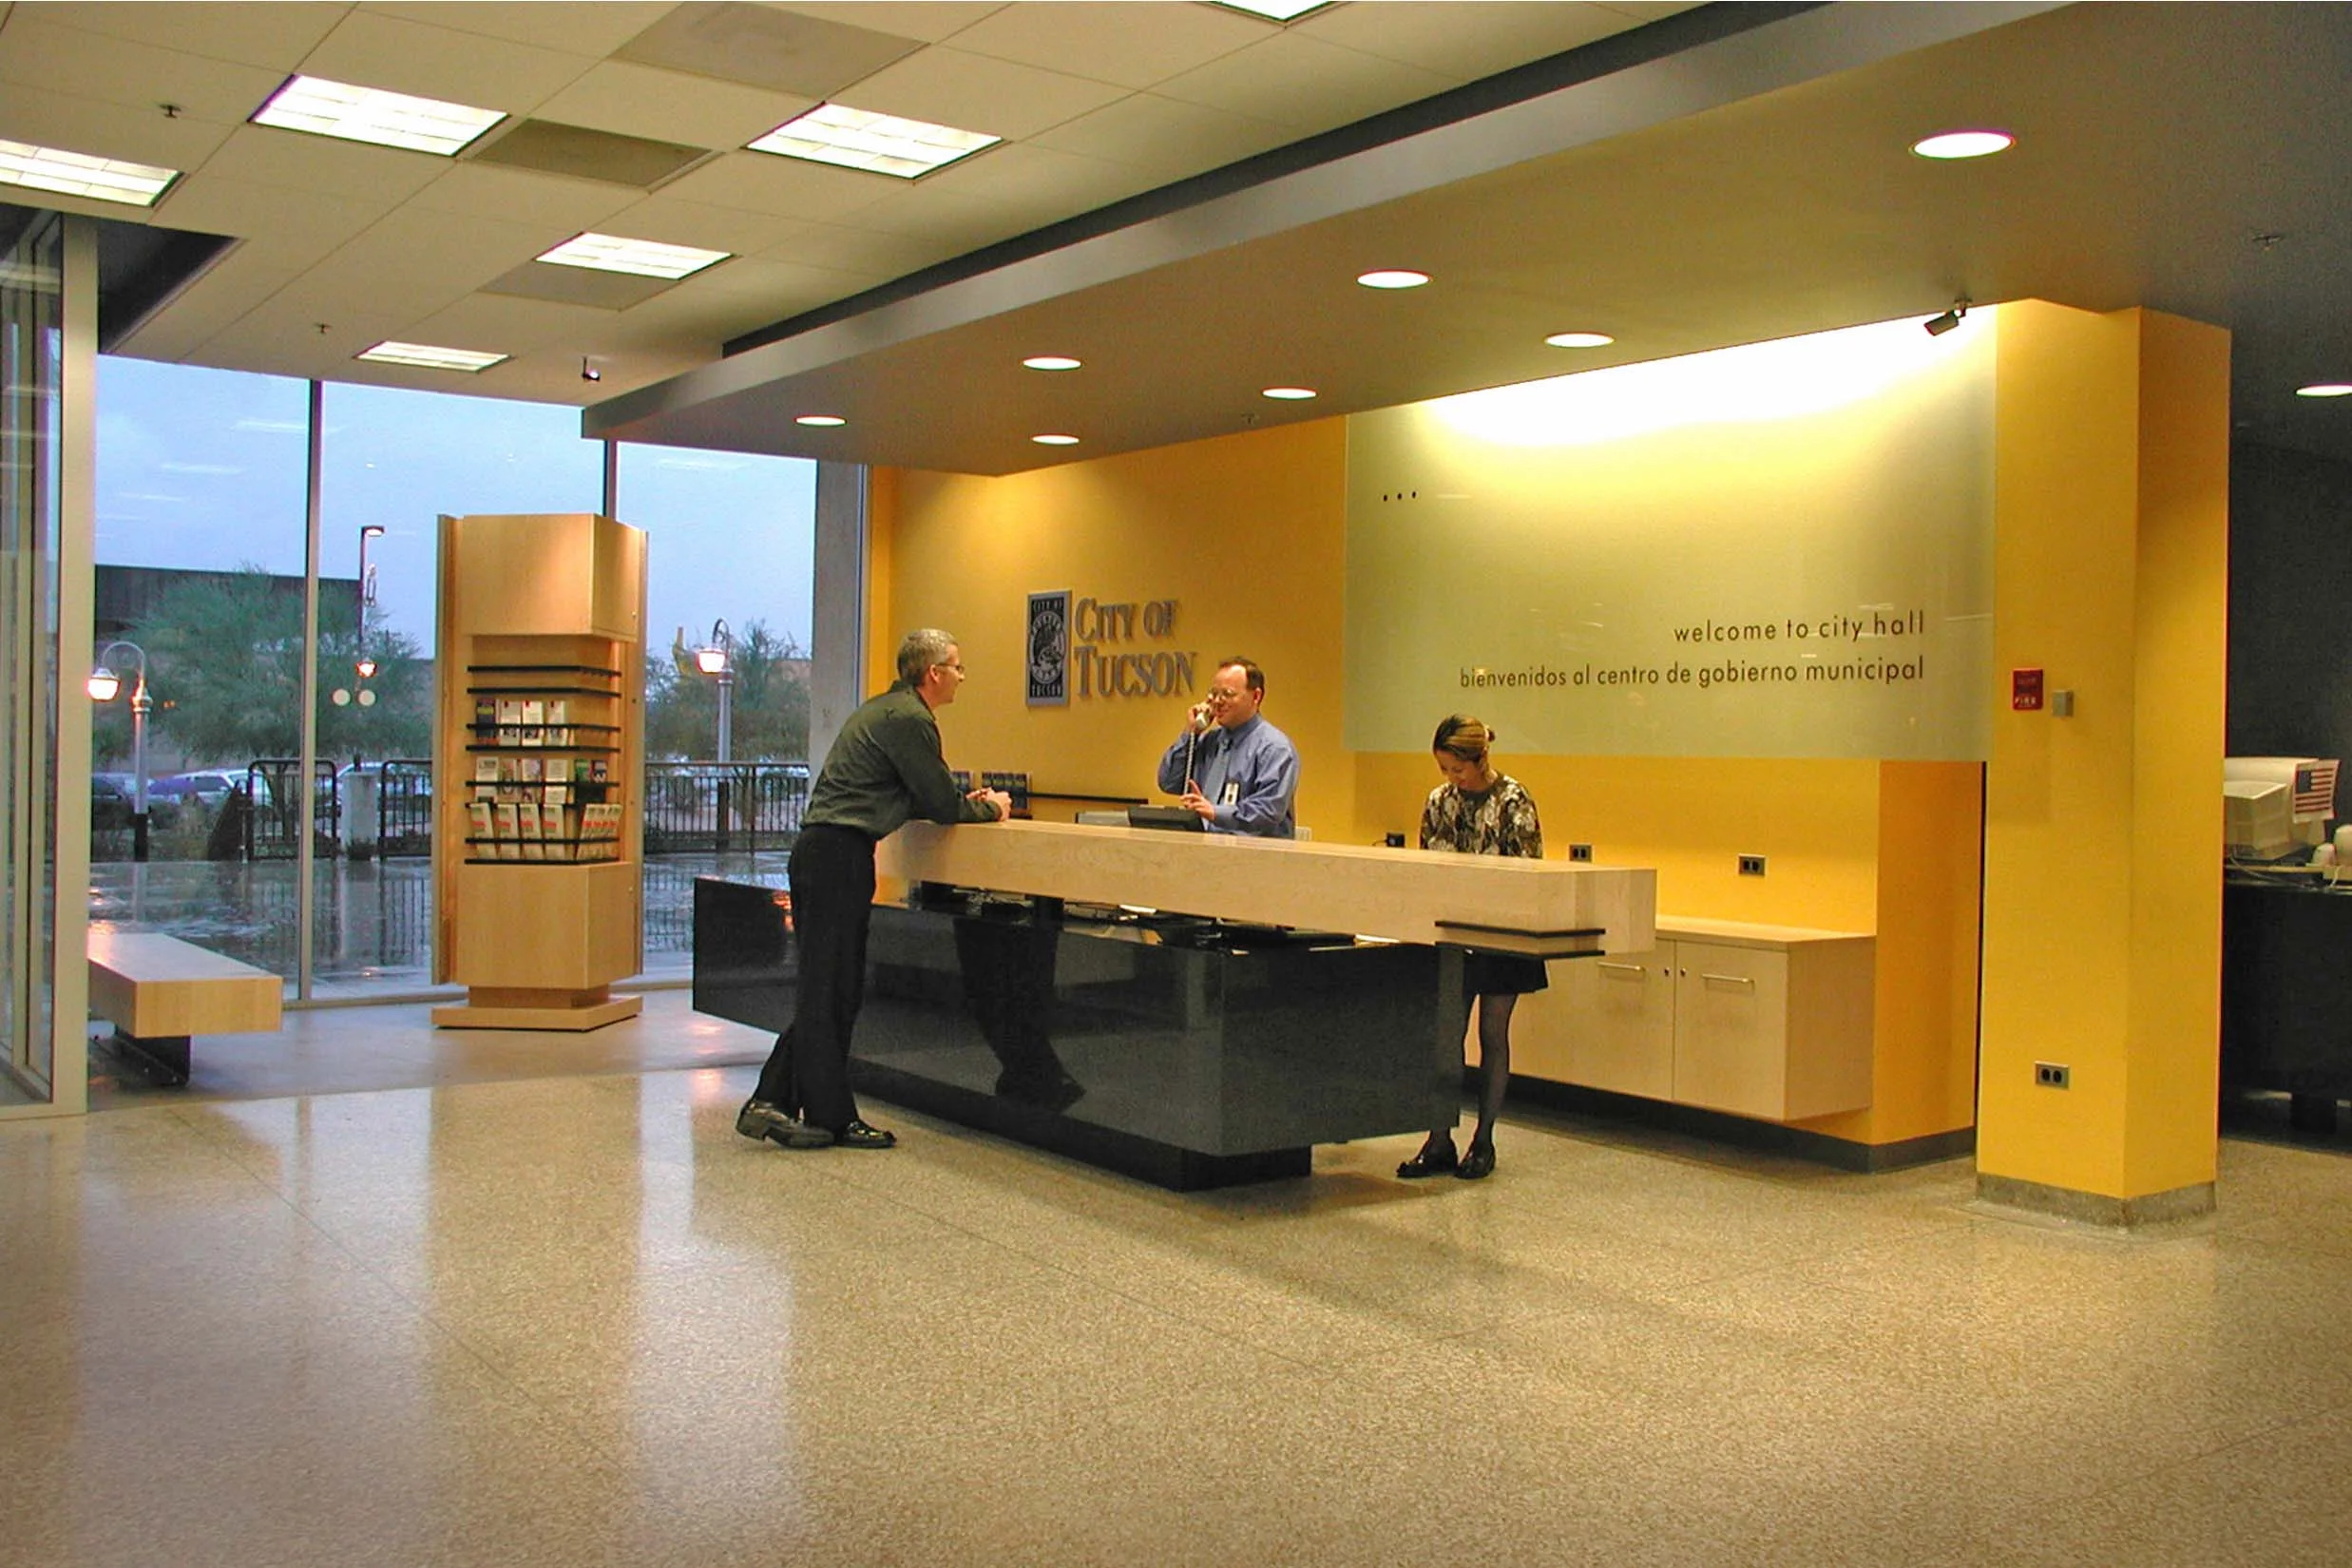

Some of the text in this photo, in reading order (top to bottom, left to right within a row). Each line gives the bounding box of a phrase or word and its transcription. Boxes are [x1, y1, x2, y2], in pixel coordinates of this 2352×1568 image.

[1143, 600, 1178, 639] OF
[1674, 609, 1923, 642] welcome to city hall
[1074, 645, 1198, 698] TUCSON
[1461, 655, 1923, 688] bienvenidos al centro de gobierno municipal
